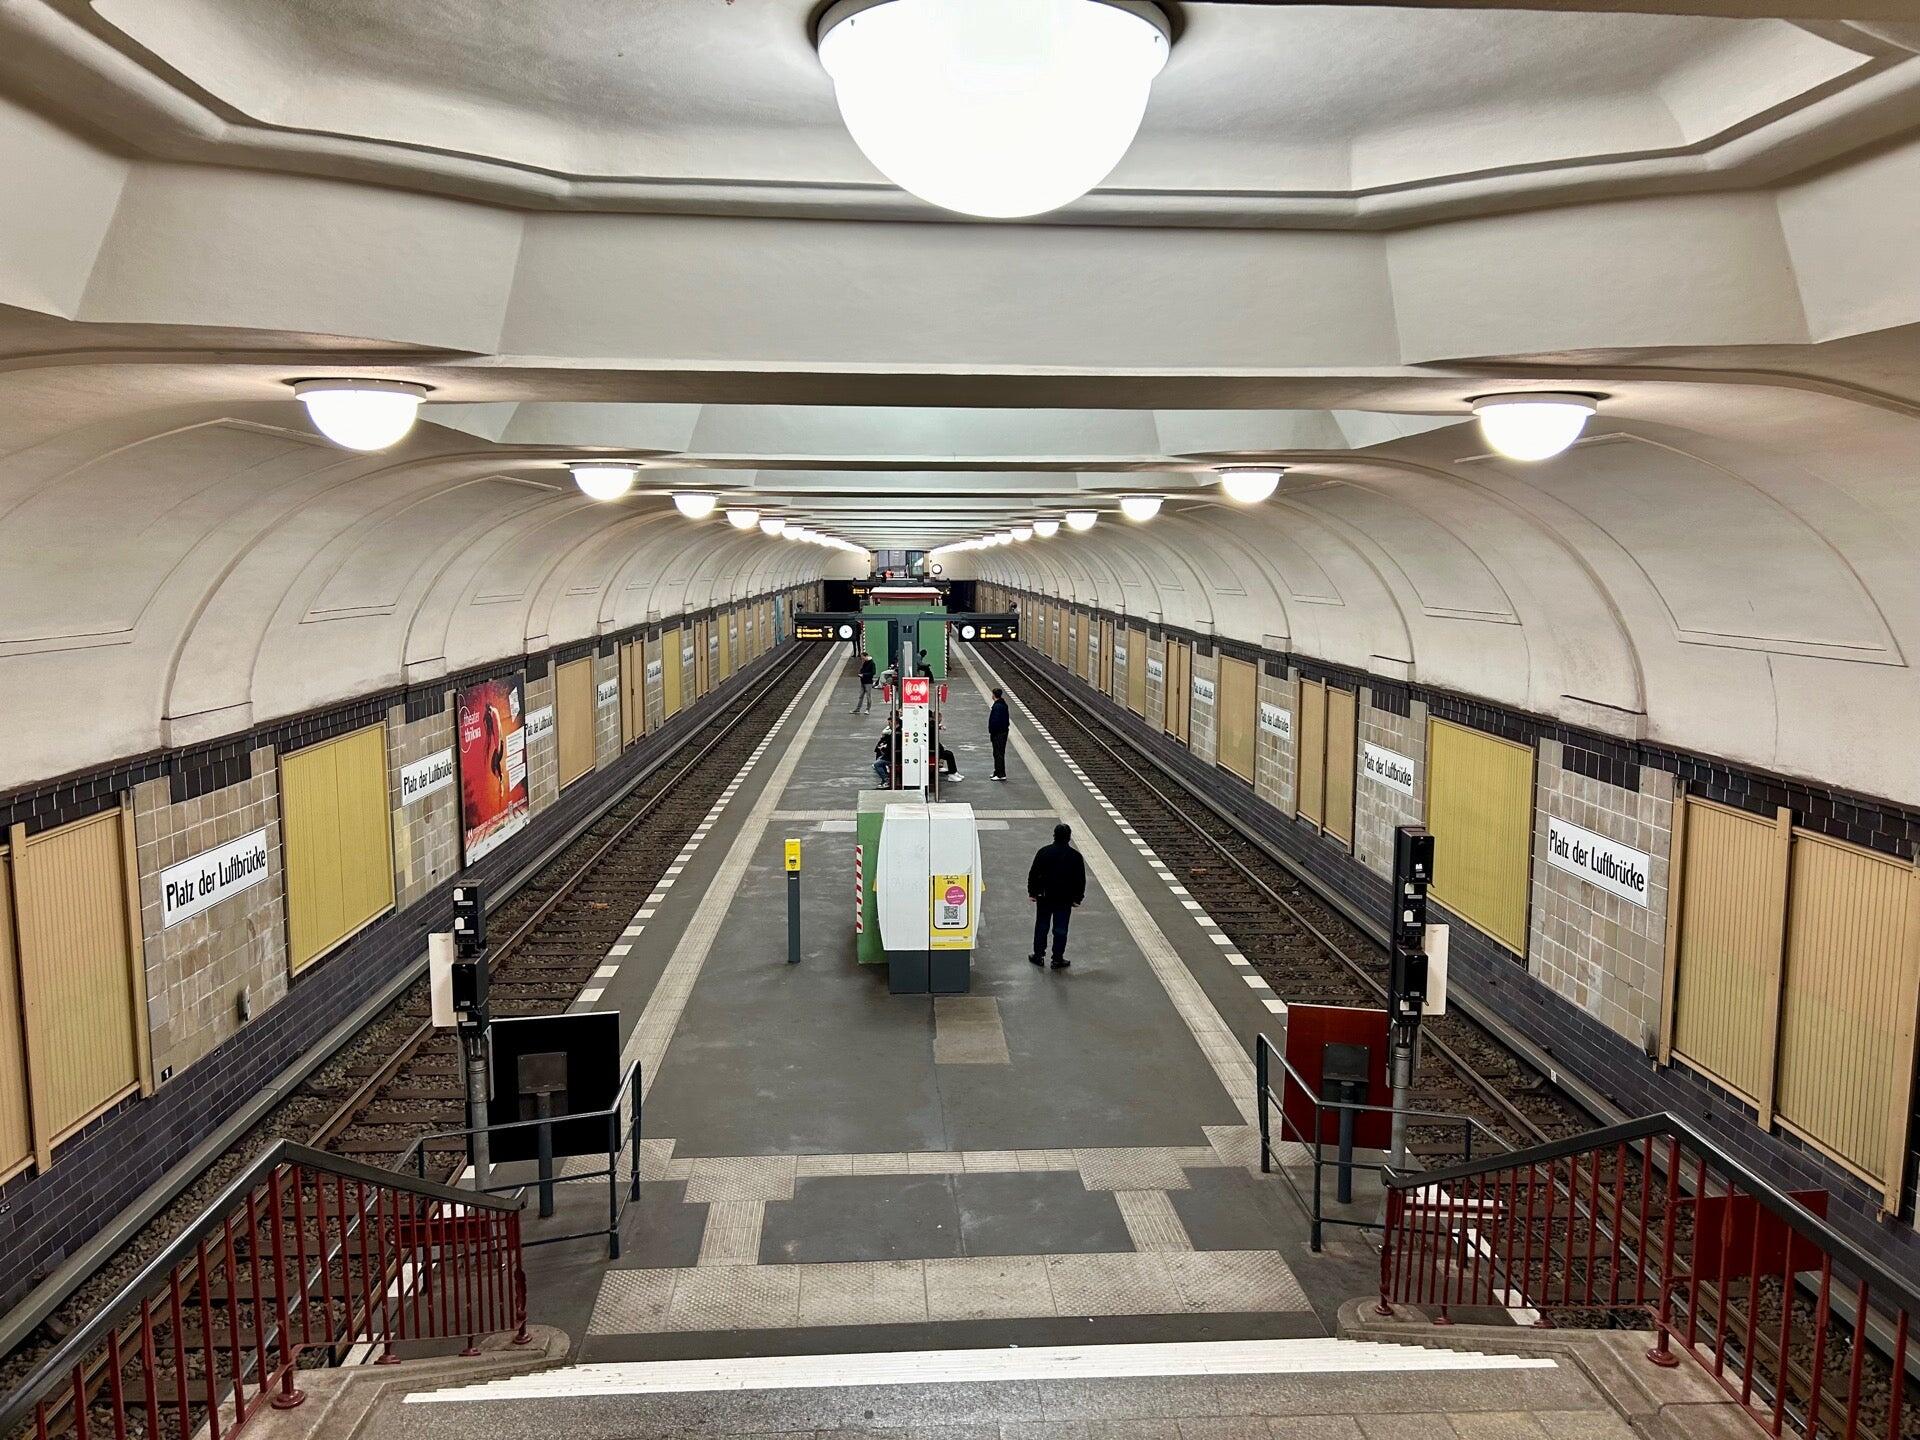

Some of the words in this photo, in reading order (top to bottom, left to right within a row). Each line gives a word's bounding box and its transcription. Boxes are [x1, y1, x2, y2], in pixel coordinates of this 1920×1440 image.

[404, 775, 417, 796] Platz
[419, 770, 428, 789] der
[428, 759, 452, 785] Luftbrücke
[166, 878, 195, 912] Platz
[198, 869, 217, 897] der
[218, 845, 266, 888] Luftbrücke
[1549, 828, 1569, 860] Platz
[1572, 840, 1588, 867] der
[1591, 846, 1645, 892] Luftbrücke
